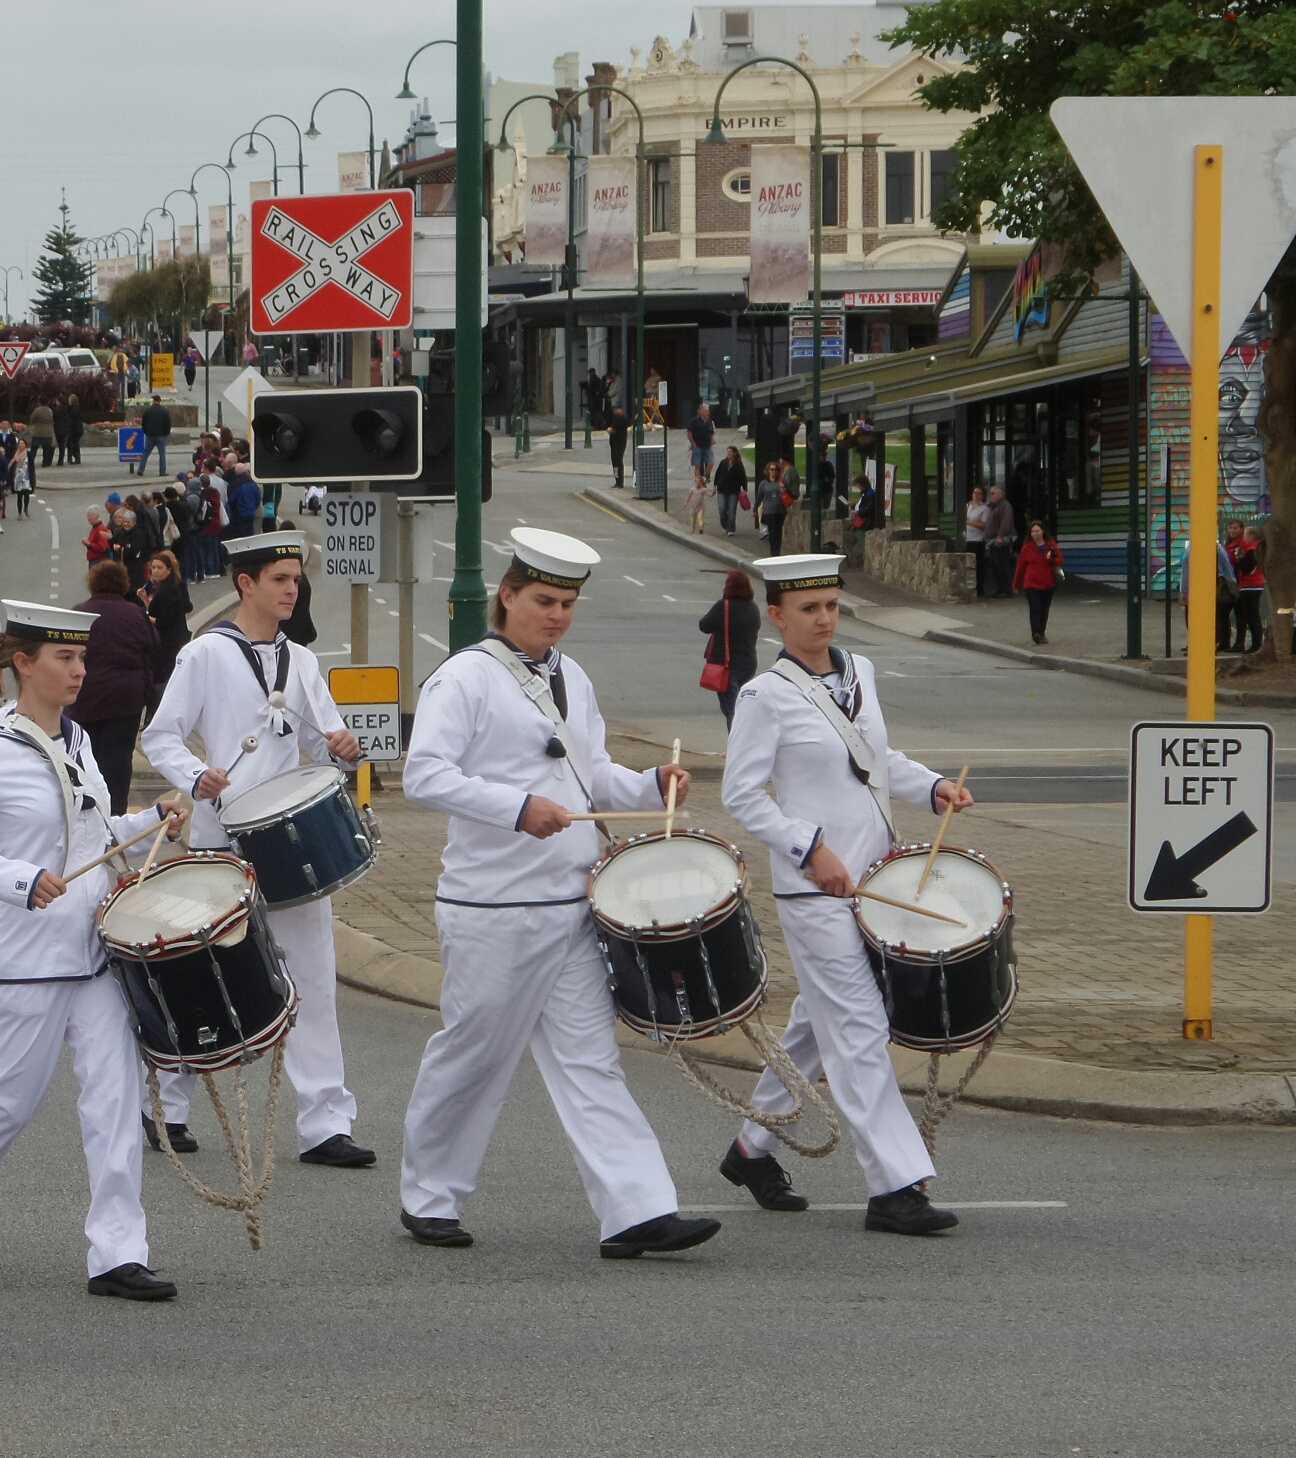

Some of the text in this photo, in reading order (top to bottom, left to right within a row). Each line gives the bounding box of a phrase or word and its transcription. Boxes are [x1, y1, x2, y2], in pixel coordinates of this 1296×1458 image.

[706, 116, 787, 130] EMPIRE
[531, 182, 561, 195] ANZAC
[594, 185, 629, 202] ANZAC
[759, 182, 802, 202] ANZAC
[271, 210, 392, 314] CROSSING
[859, 291, 943, 304] TAXI SERVIC
[326, 501, 376, 527] STOP
[327, 535, 375, 551] ON RED
[327, 559, 375, 575] SIGNAL
[47, 630, 60, 639] TS
[358, 735, 397, 752] EAR
[1161, 738, 1242, 767] KEEP
[1164, 777, 1238, 806] LEFT
